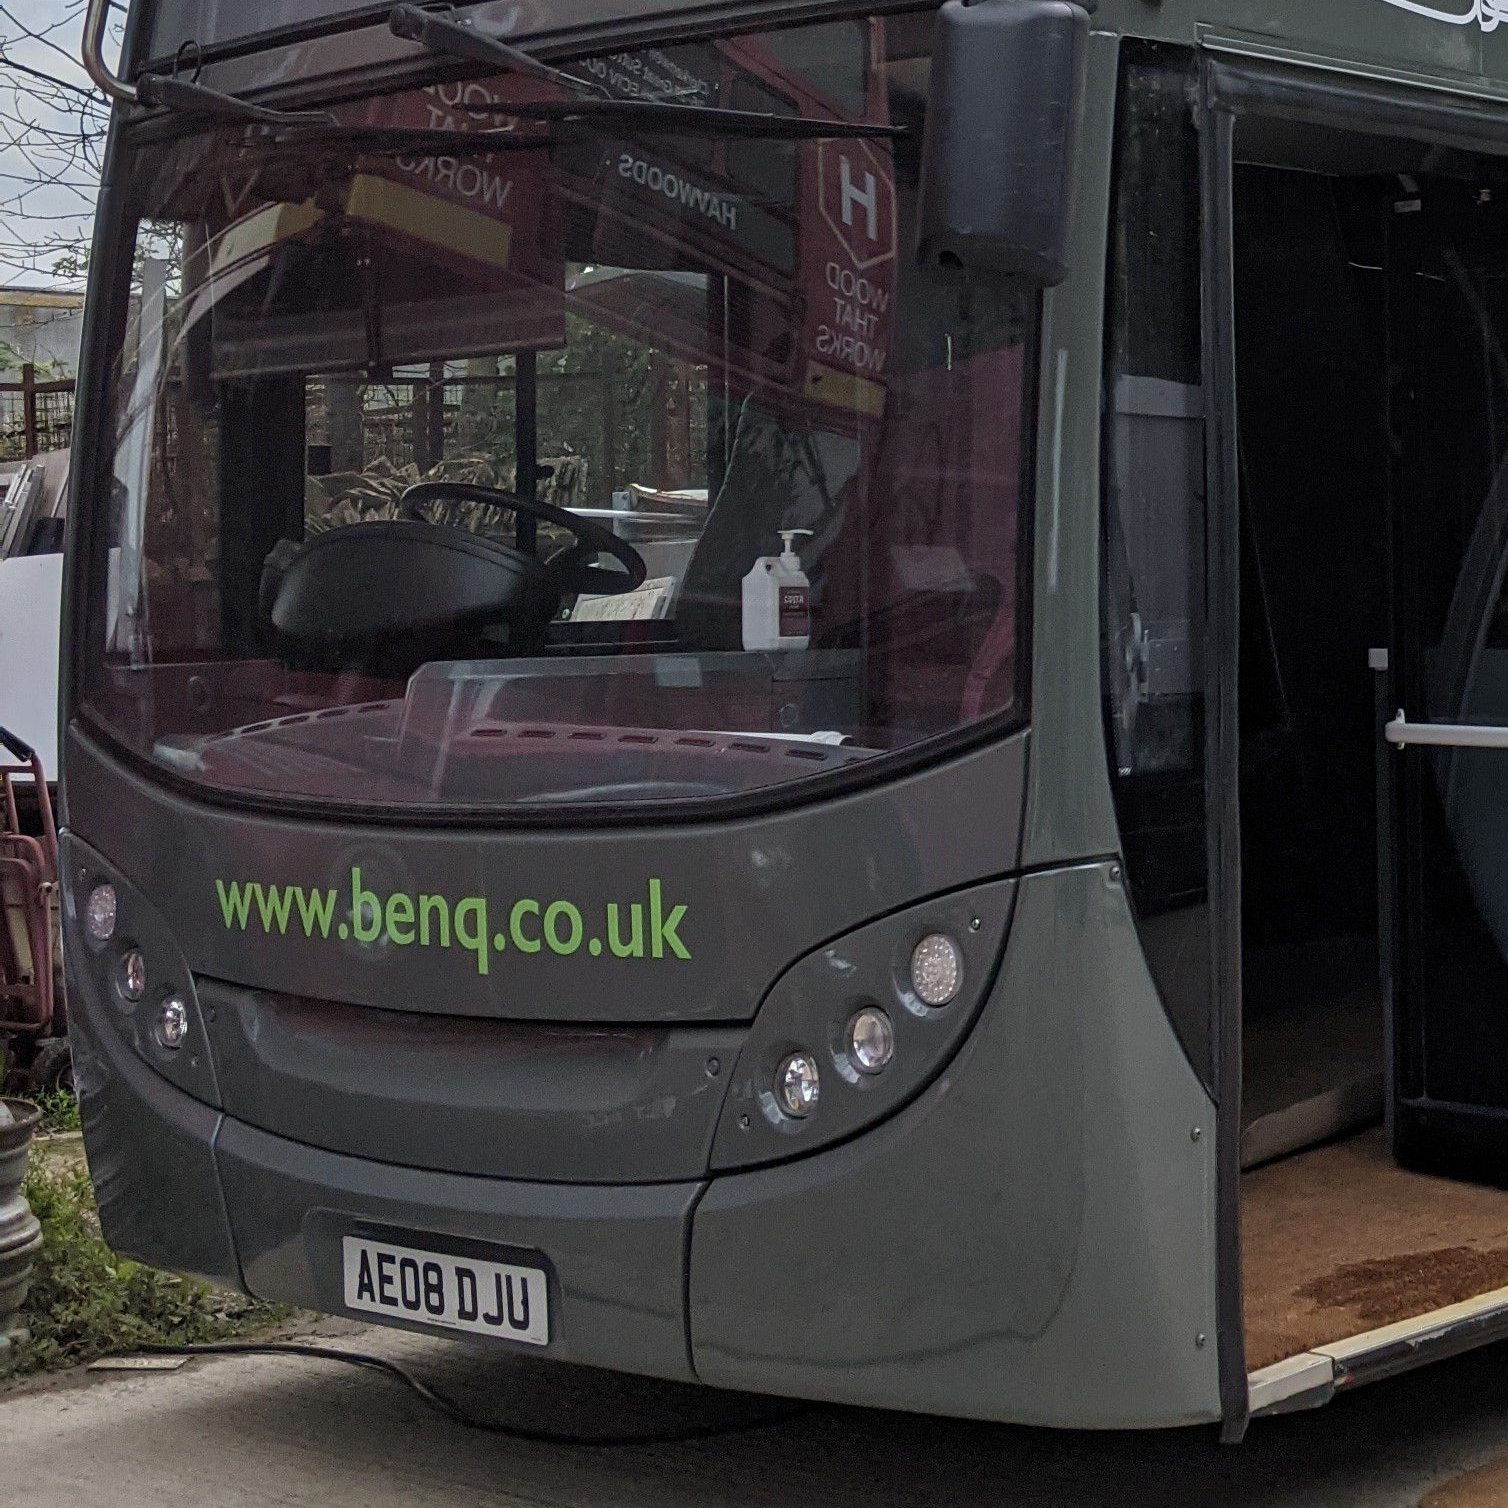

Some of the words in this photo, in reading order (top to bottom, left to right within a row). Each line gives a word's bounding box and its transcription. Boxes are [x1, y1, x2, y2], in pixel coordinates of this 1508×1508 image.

[216, 868, 692, 975] www.benq.co.uk
[357, 1249, 445, 1316] AE08
[455, 1266, 530, 1331] DJU
